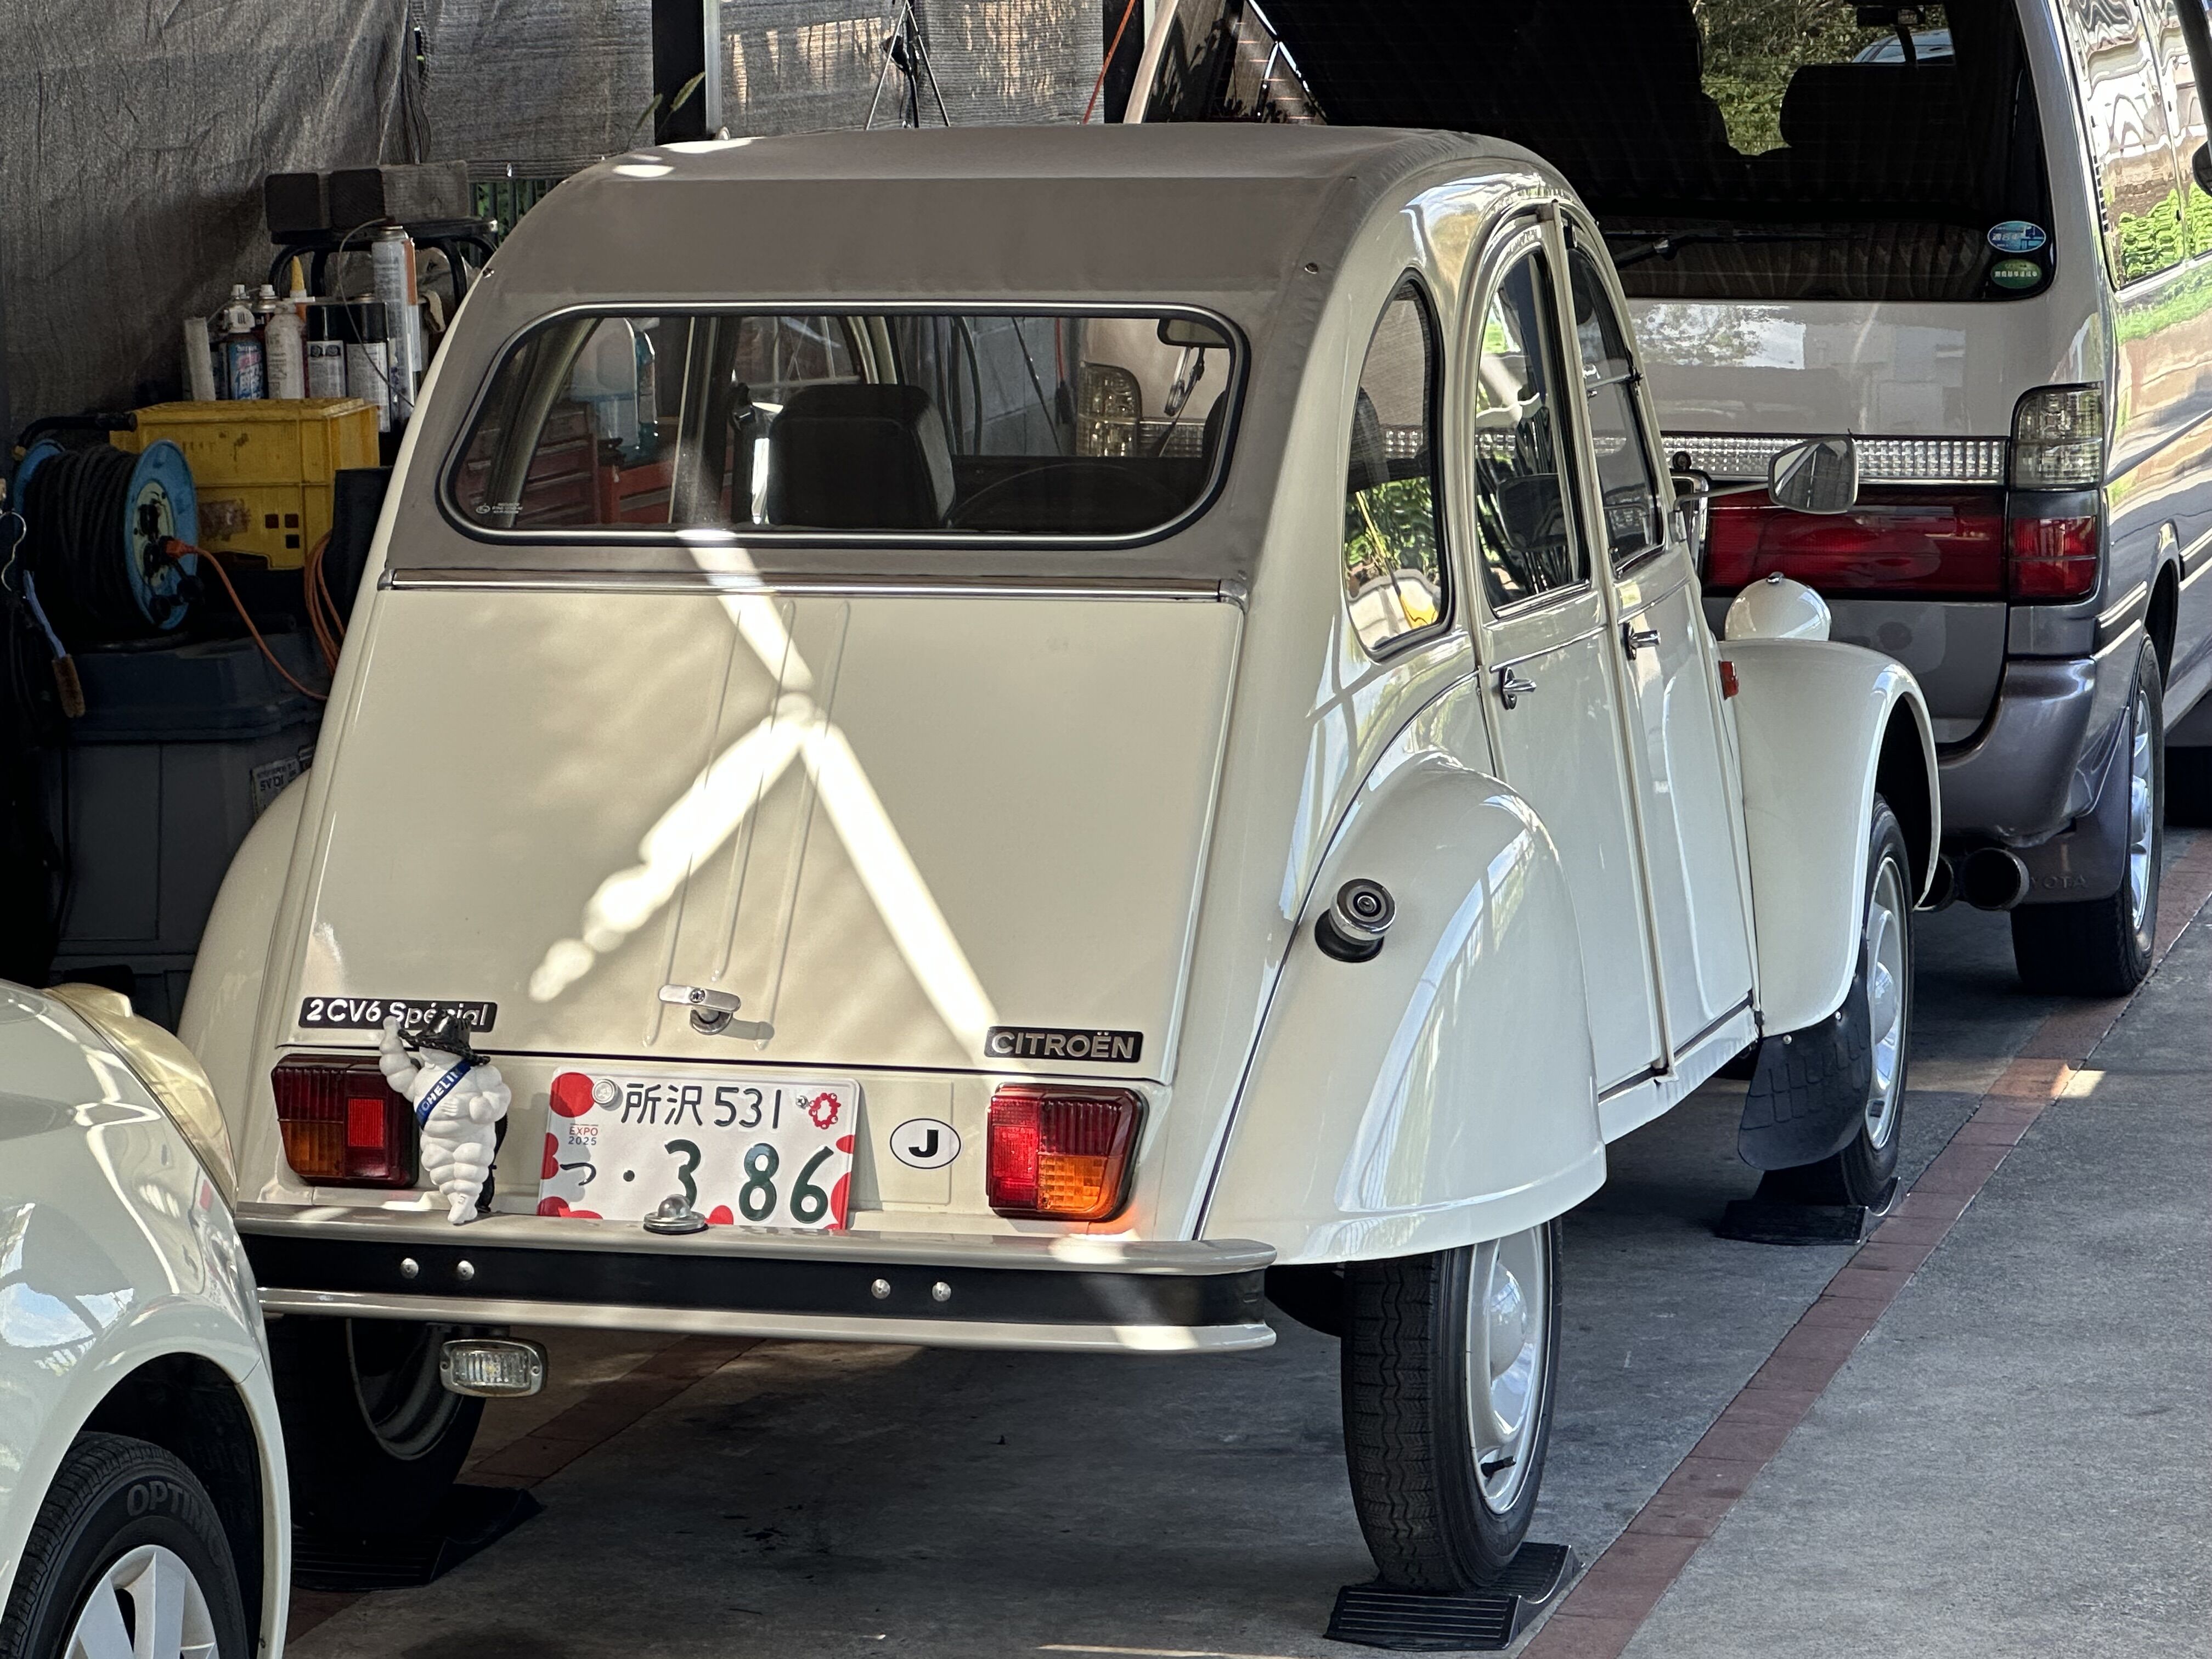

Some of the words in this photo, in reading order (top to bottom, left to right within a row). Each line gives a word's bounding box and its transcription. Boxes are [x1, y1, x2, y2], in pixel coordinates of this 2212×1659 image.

[2031, 874, 2087, 889] YOTA
[306, 998, 381, 1023] 2CV6
[992, 1031, 1135, 1059] CITROËN
[620, 1083, 703, 1126] 所沢
[714, 1086, 782, 1129] 531
[568, 1136, 597, 1146] 2025
[569, 1126, 598, 1136] EXPO
[909, 1129, 939, 1158] J
